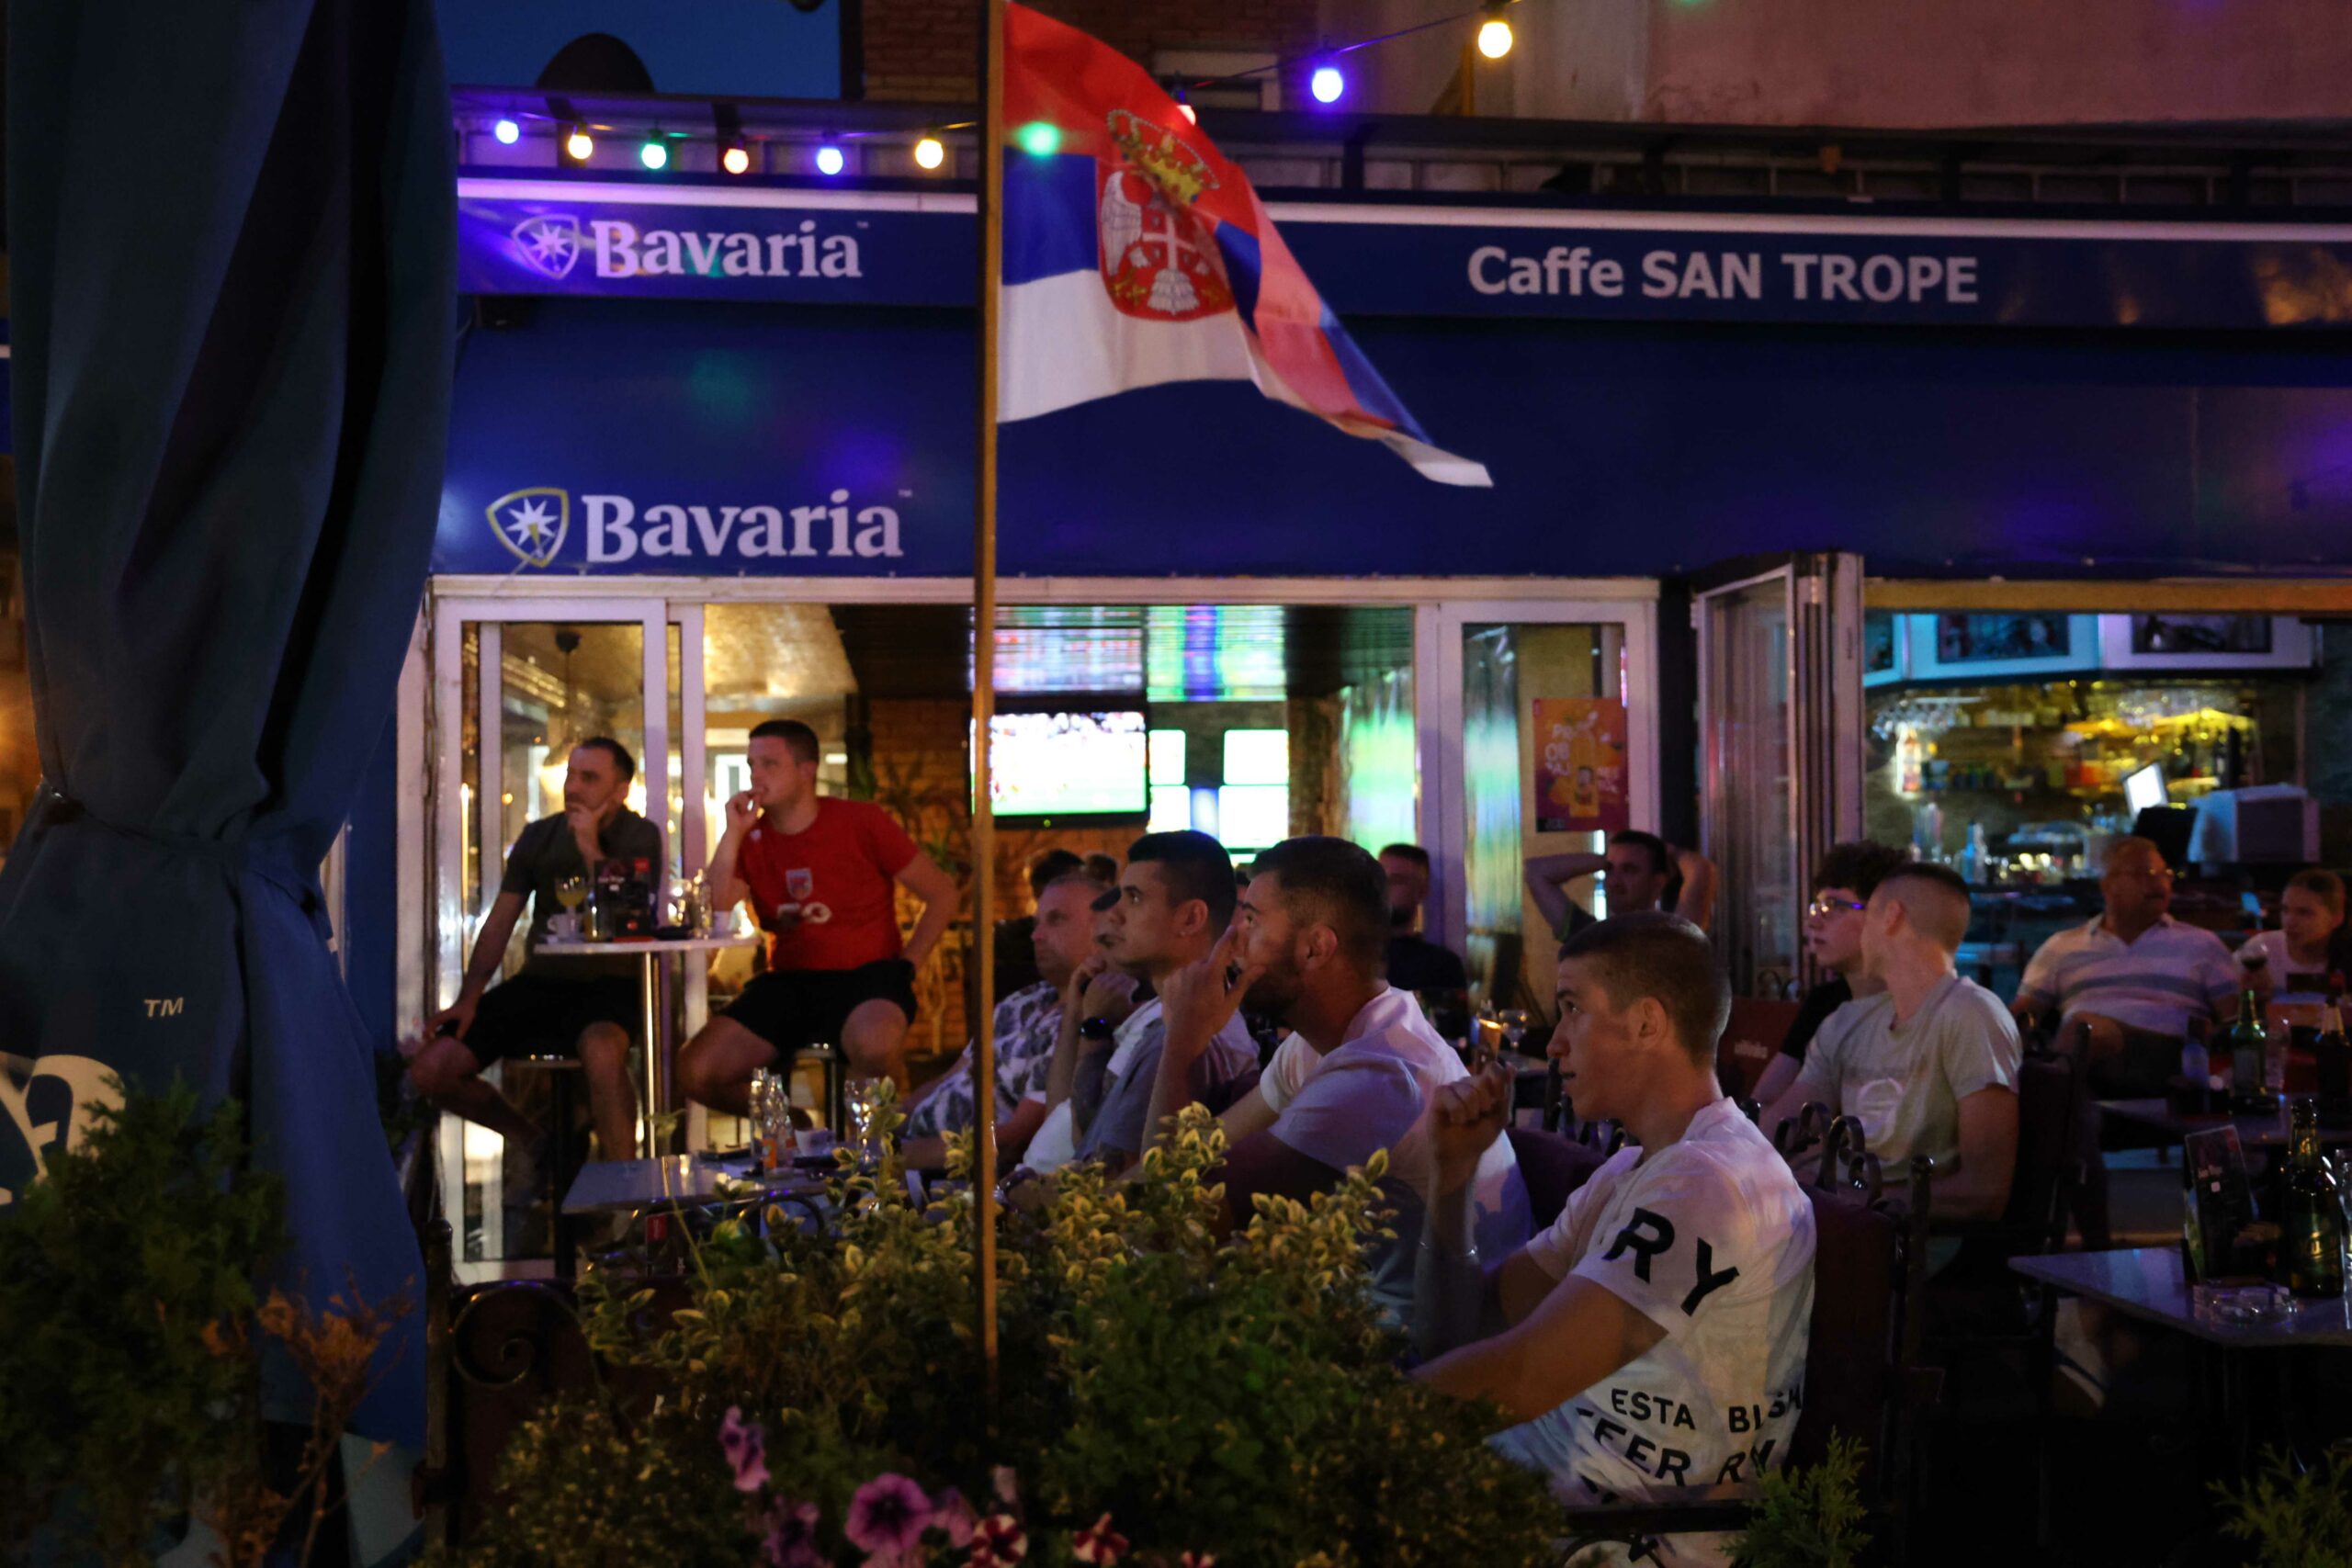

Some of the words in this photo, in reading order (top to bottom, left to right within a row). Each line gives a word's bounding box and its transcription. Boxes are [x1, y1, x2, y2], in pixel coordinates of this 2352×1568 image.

[590, 220, 863, 278] Bavaria
[1468, 245, 1623, 297] Caffe
[1641, 251, 1761, 301] SAN
[1781, 254, 1979, 304] TROPE
[581, 488, 904, 563] Bavaria
[143, 997, 184, 1019] TM
[1611, 1388, 1696, 1430] ESTA
